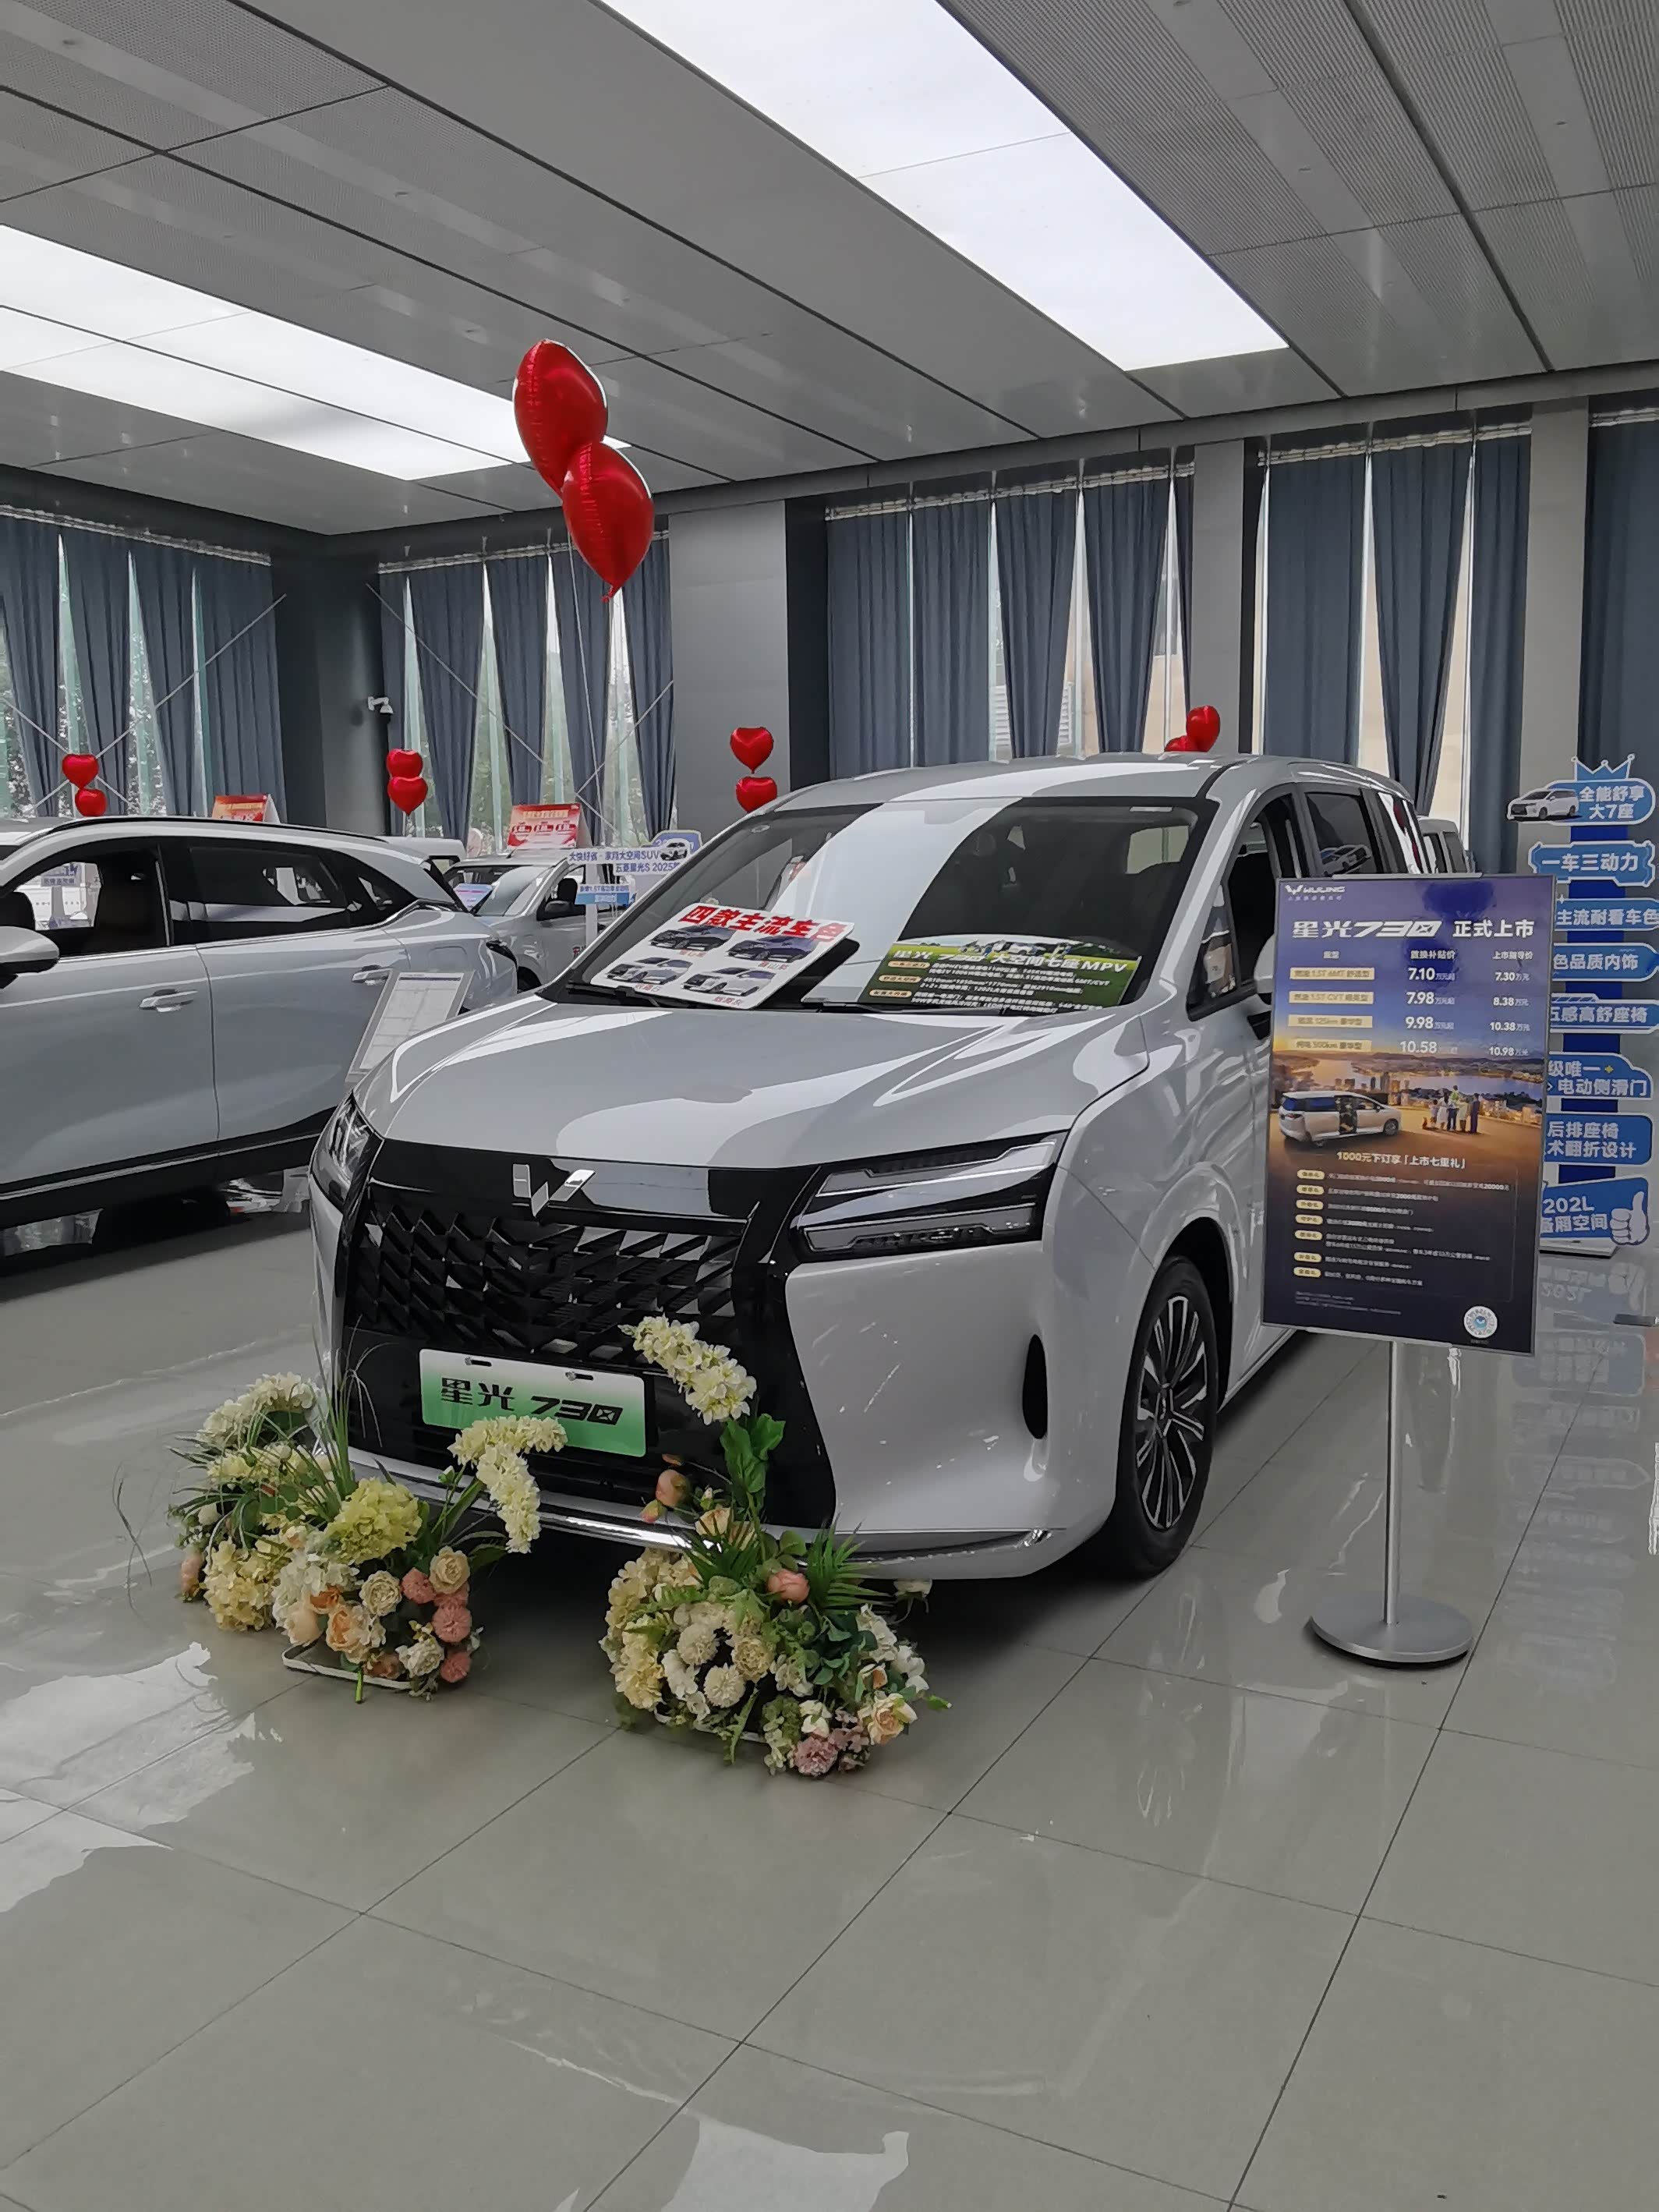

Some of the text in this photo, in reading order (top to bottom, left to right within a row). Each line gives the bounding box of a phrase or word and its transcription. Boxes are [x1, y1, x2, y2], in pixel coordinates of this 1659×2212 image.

[1579, 786, 1645, 802] 全能舒享
[1589, 804, 1634, 819] 大7座
[1542, 853, 1639, 872] 一车三动力
[679, 905, 847, 941] 四款主流车色
[1452, 918, 1534, 939] 正式上市
[1558, 1078, 1647, 1096] 电动侧滑门
[1547, 1120, 1619, 1139] 后排座椅
[440, 1377, 624, 1425] 星光 730
